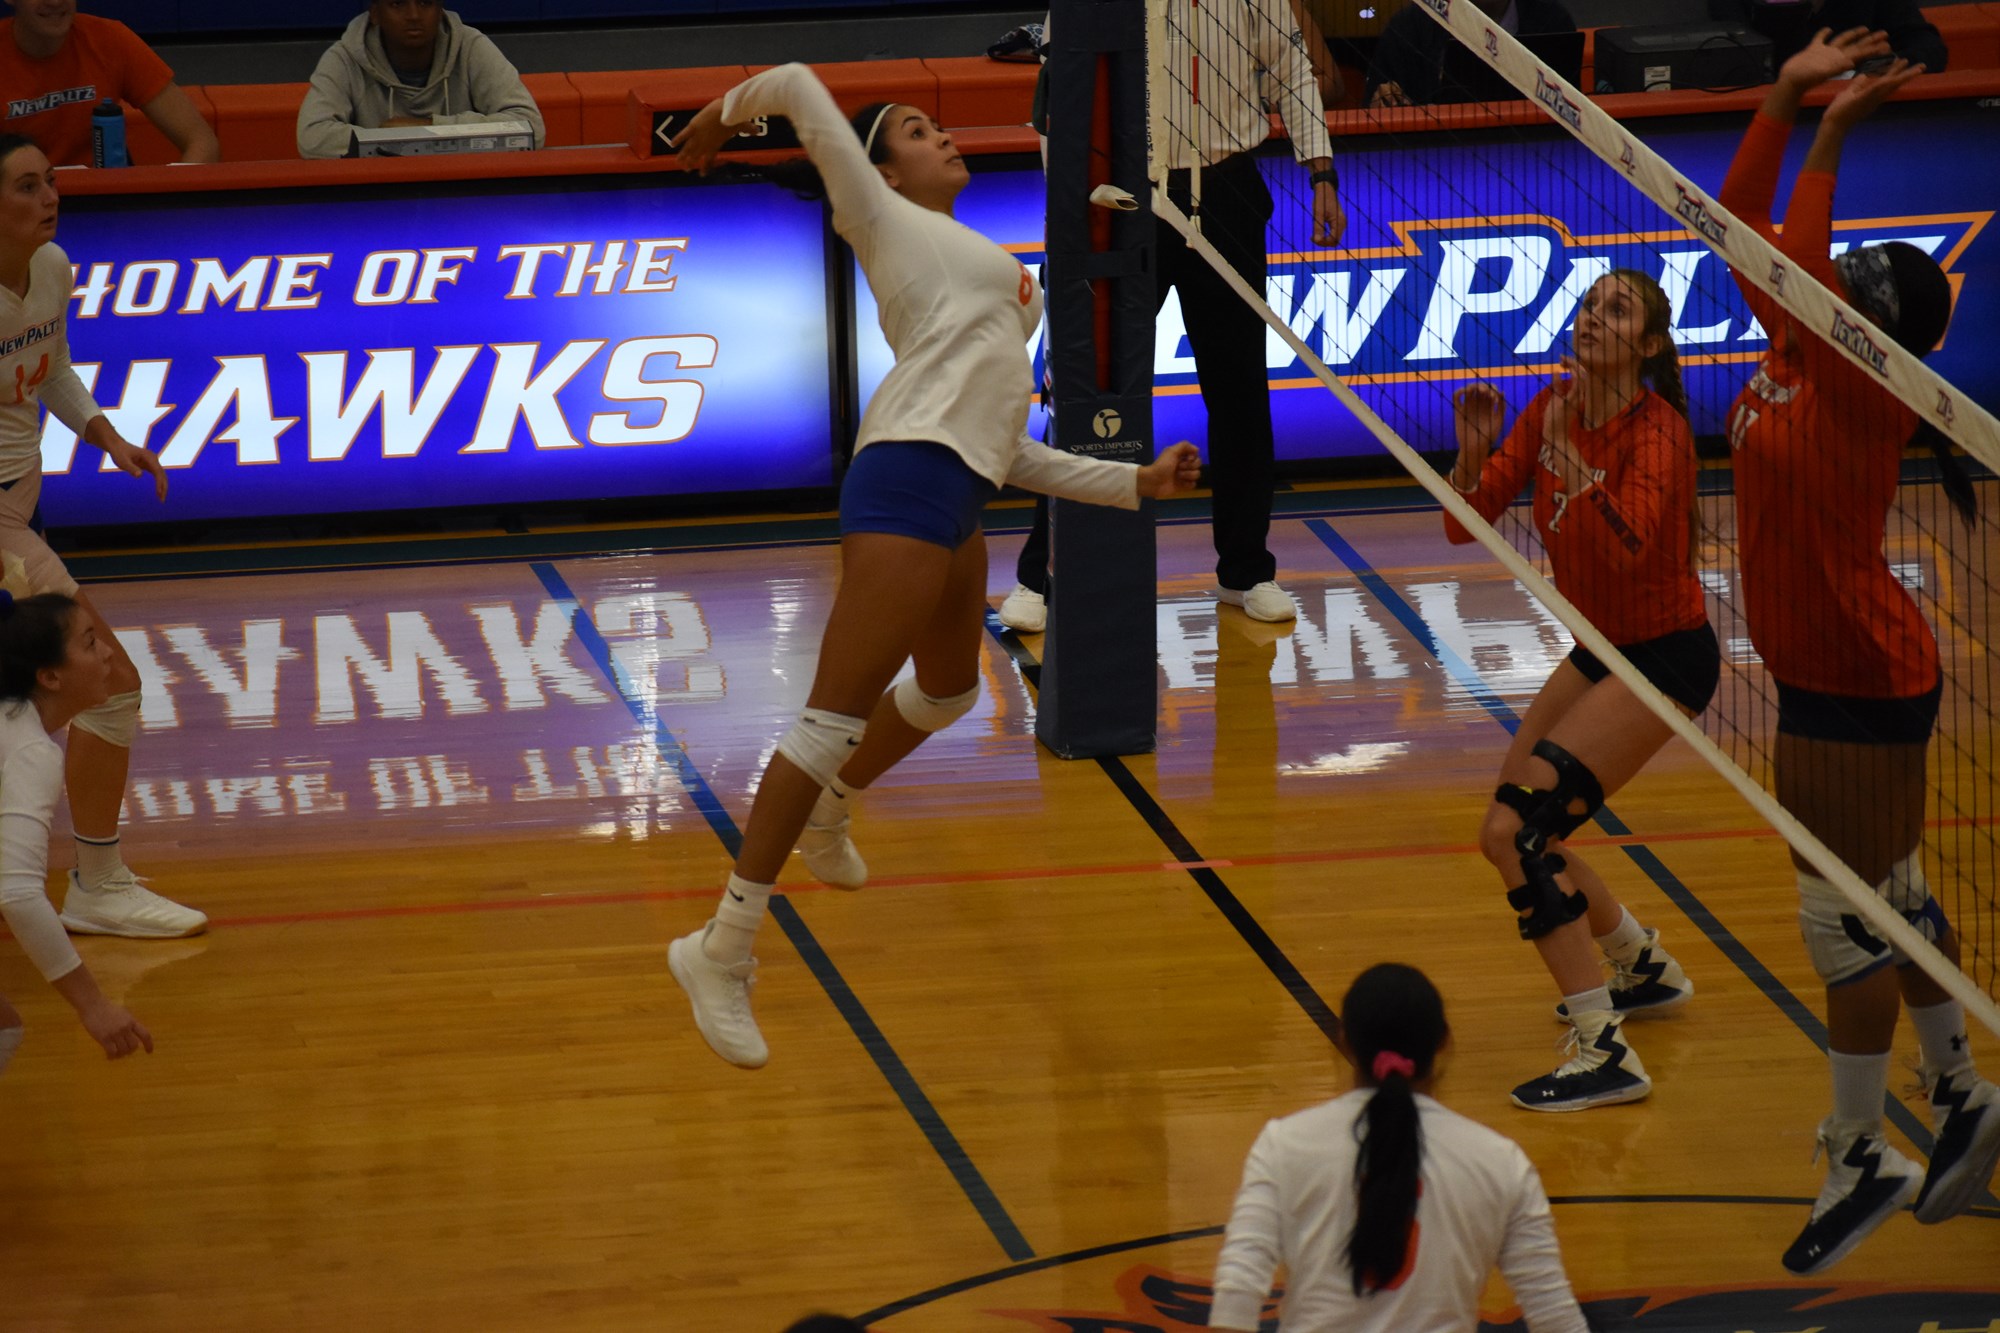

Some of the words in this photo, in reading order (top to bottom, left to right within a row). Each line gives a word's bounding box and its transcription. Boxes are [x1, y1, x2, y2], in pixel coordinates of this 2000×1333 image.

[70, 253, 334, 319] HOME
[353, 246, 478, 306] OF
[499, 236, 691, 300] THE
[41, 333, 719, 476] HAWKS
[1070, 442, 1104, 455] SPORTS
[1104, 440, 1144, 451] IMPORTS
